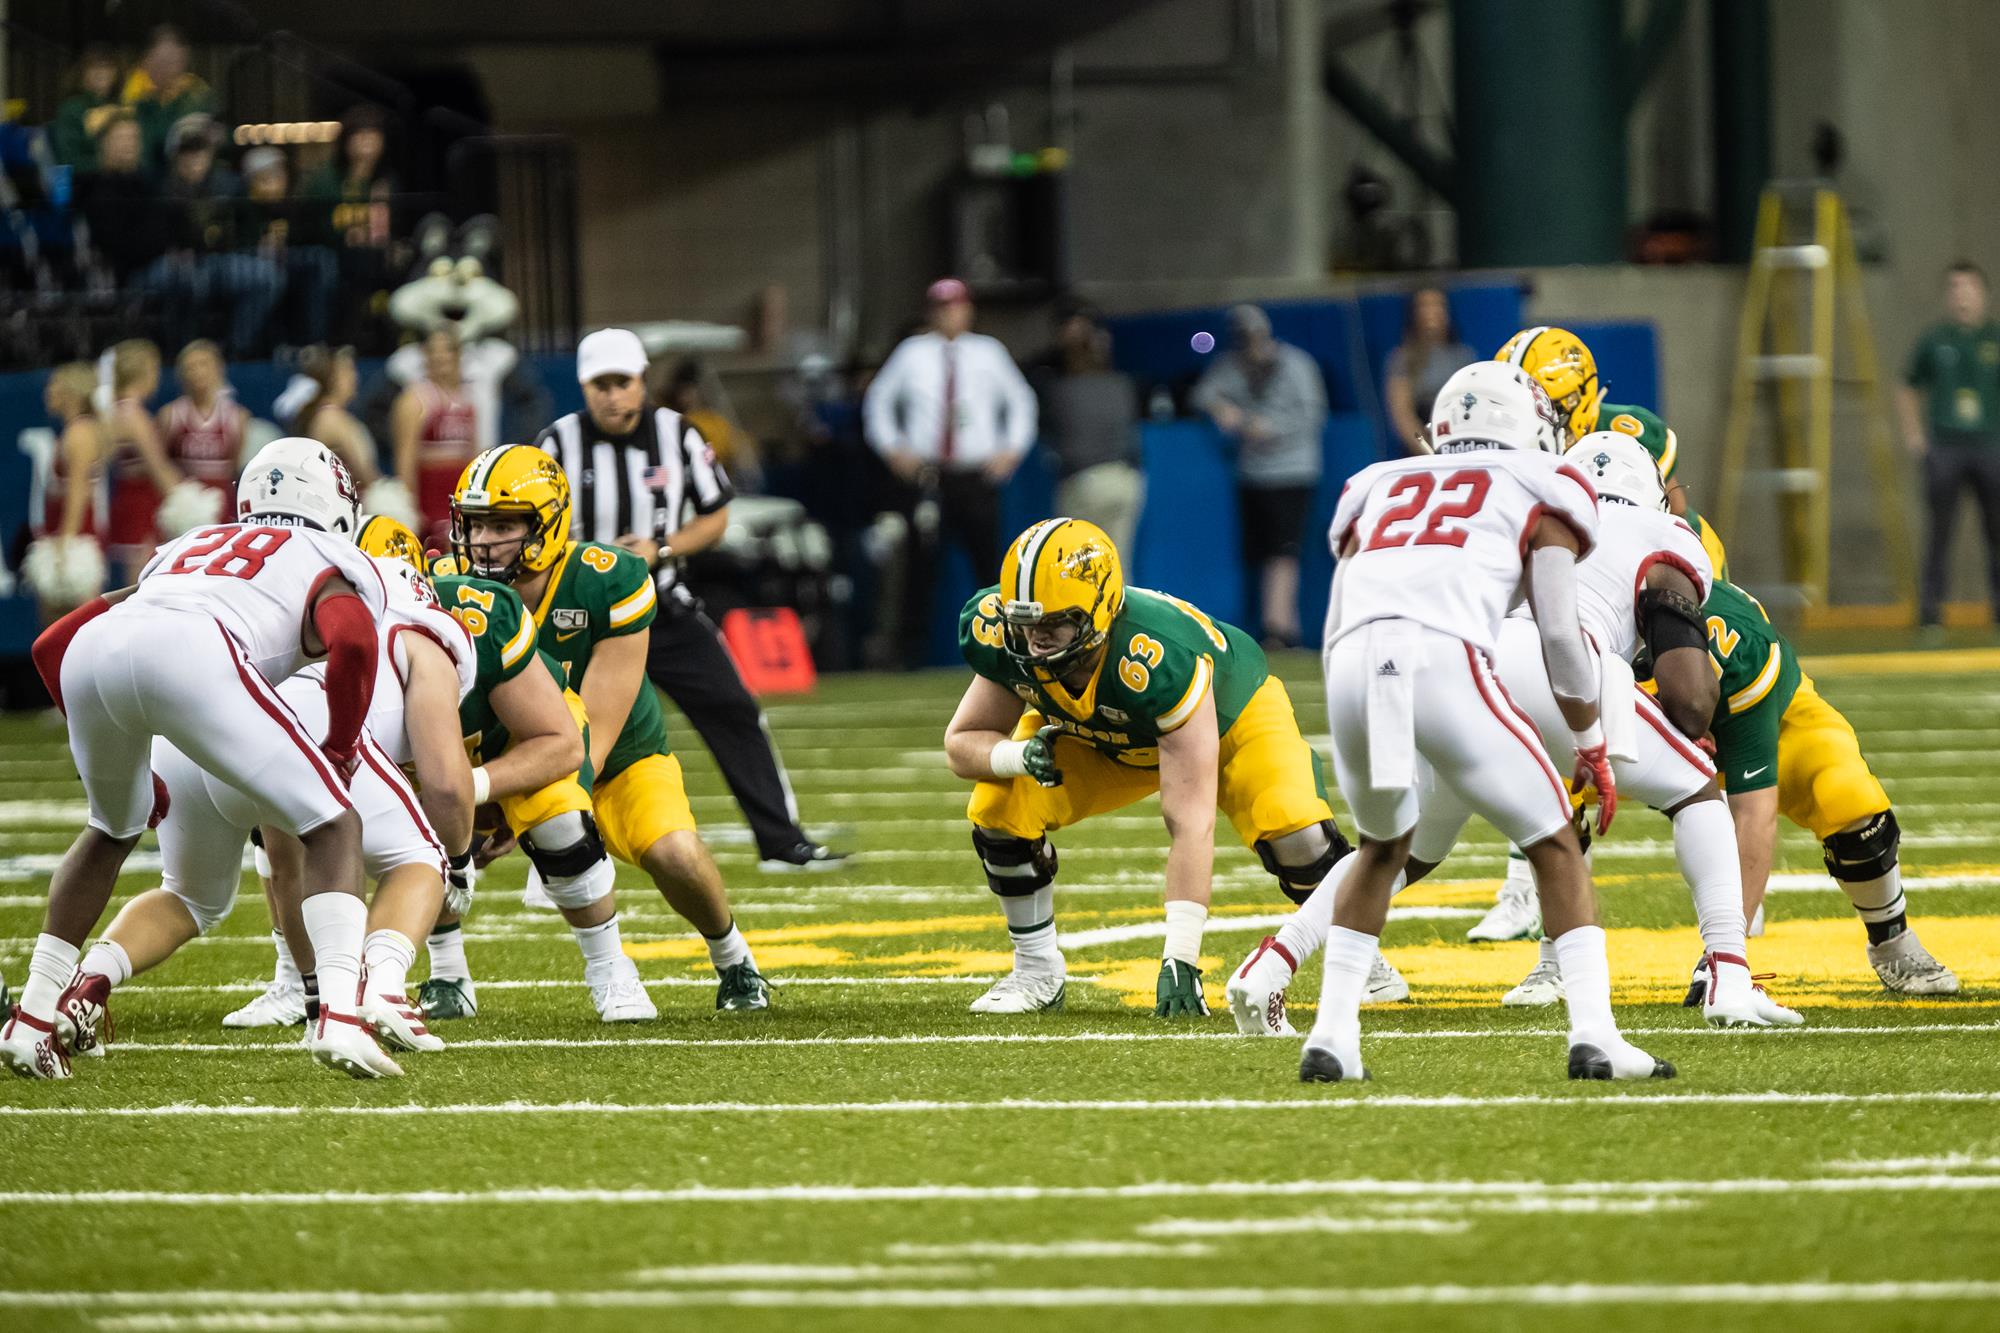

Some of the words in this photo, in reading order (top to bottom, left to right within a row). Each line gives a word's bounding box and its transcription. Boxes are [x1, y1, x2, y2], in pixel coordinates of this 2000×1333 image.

[1441, 441, 1499, 455] Riddell
[247, 514, 304, 527] Riddell
[1363, 469, 1493, 551] 22
[168, 526, 292, 580] 28
[581, 546, 618, 573] 8
[1119, 633, 1165, 693] 63
